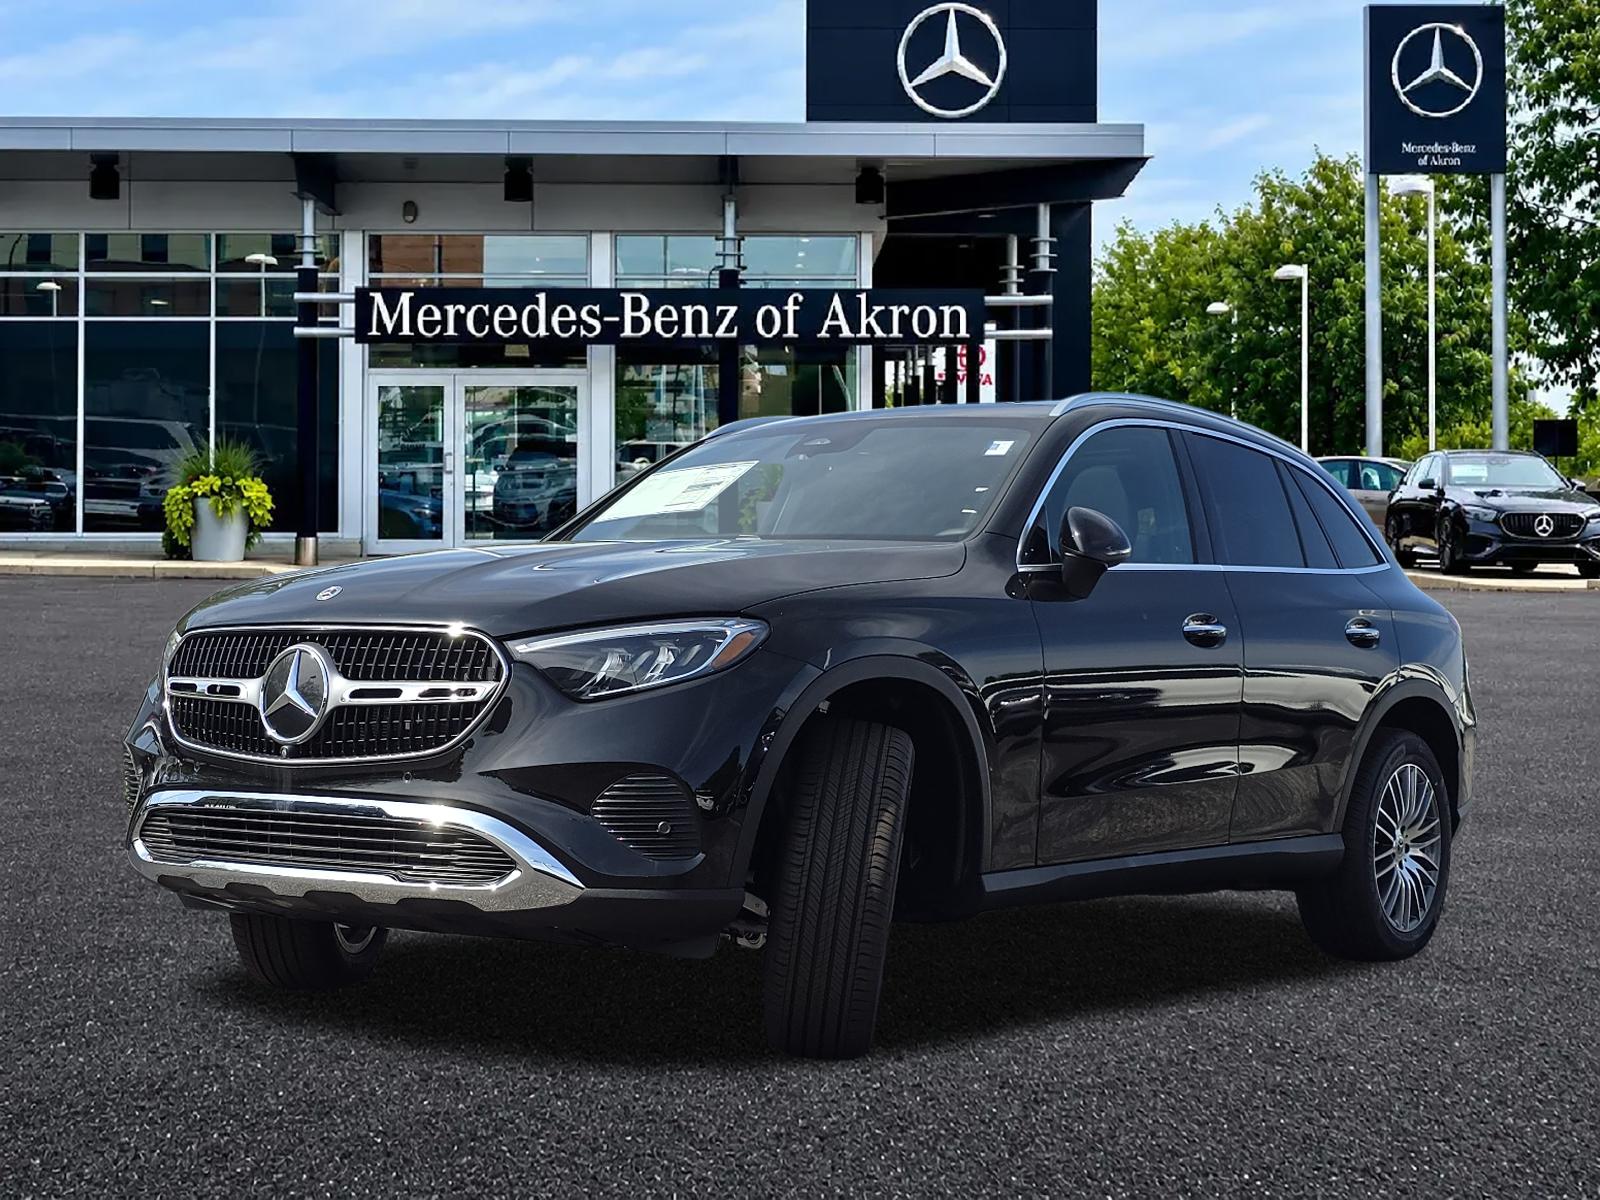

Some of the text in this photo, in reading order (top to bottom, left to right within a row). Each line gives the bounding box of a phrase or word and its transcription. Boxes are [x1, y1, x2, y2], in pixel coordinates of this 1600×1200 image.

[1401, 141, 1476, 153] Mercedes-Benz
[1417, 154, 1461, 166] of Akron
[367, 292, 970, 338] Mercedes-Benz of Akron
